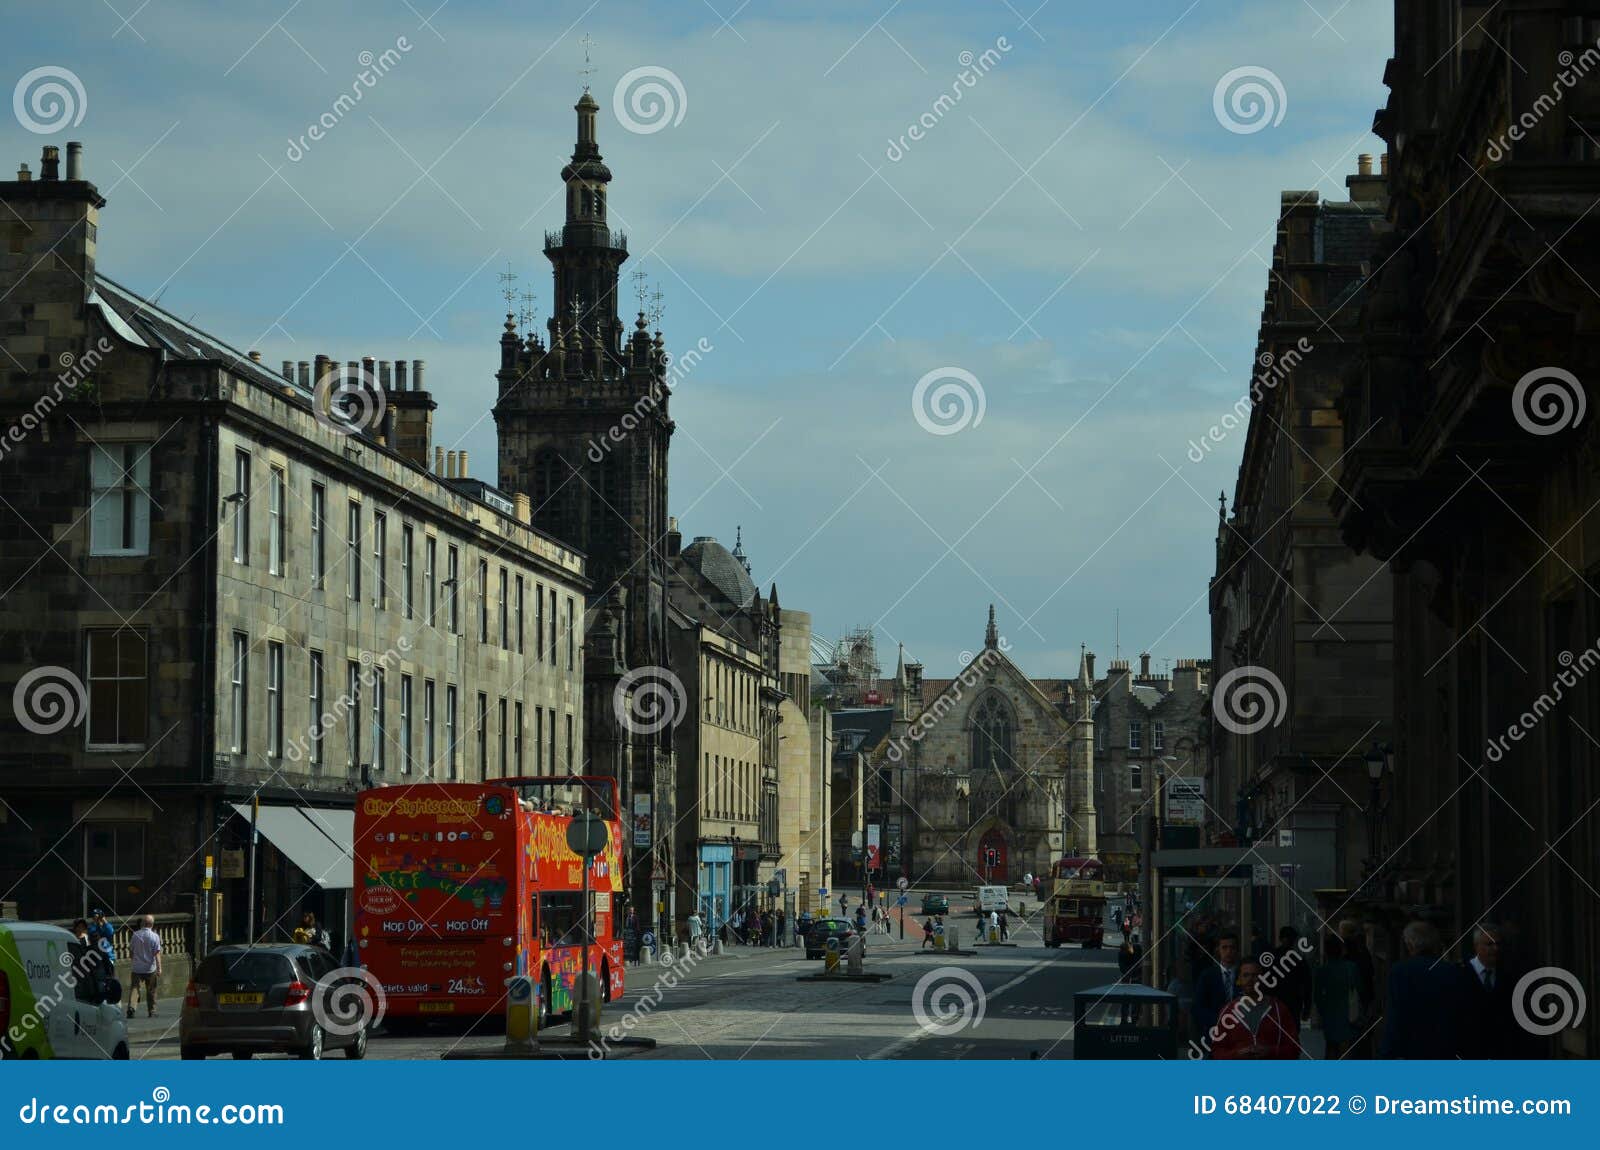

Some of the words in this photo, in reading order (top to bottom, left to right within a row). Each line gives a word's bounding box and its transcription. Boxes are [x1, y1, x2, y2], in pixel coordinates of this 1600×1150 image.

[383, 921, 405, 932] Hop
[446, 921, 469, 932] Hop
[471, 918, 489, 931] Off
[27, 960, 51, 979] Orona
[448, 979, 463, 994] 24
